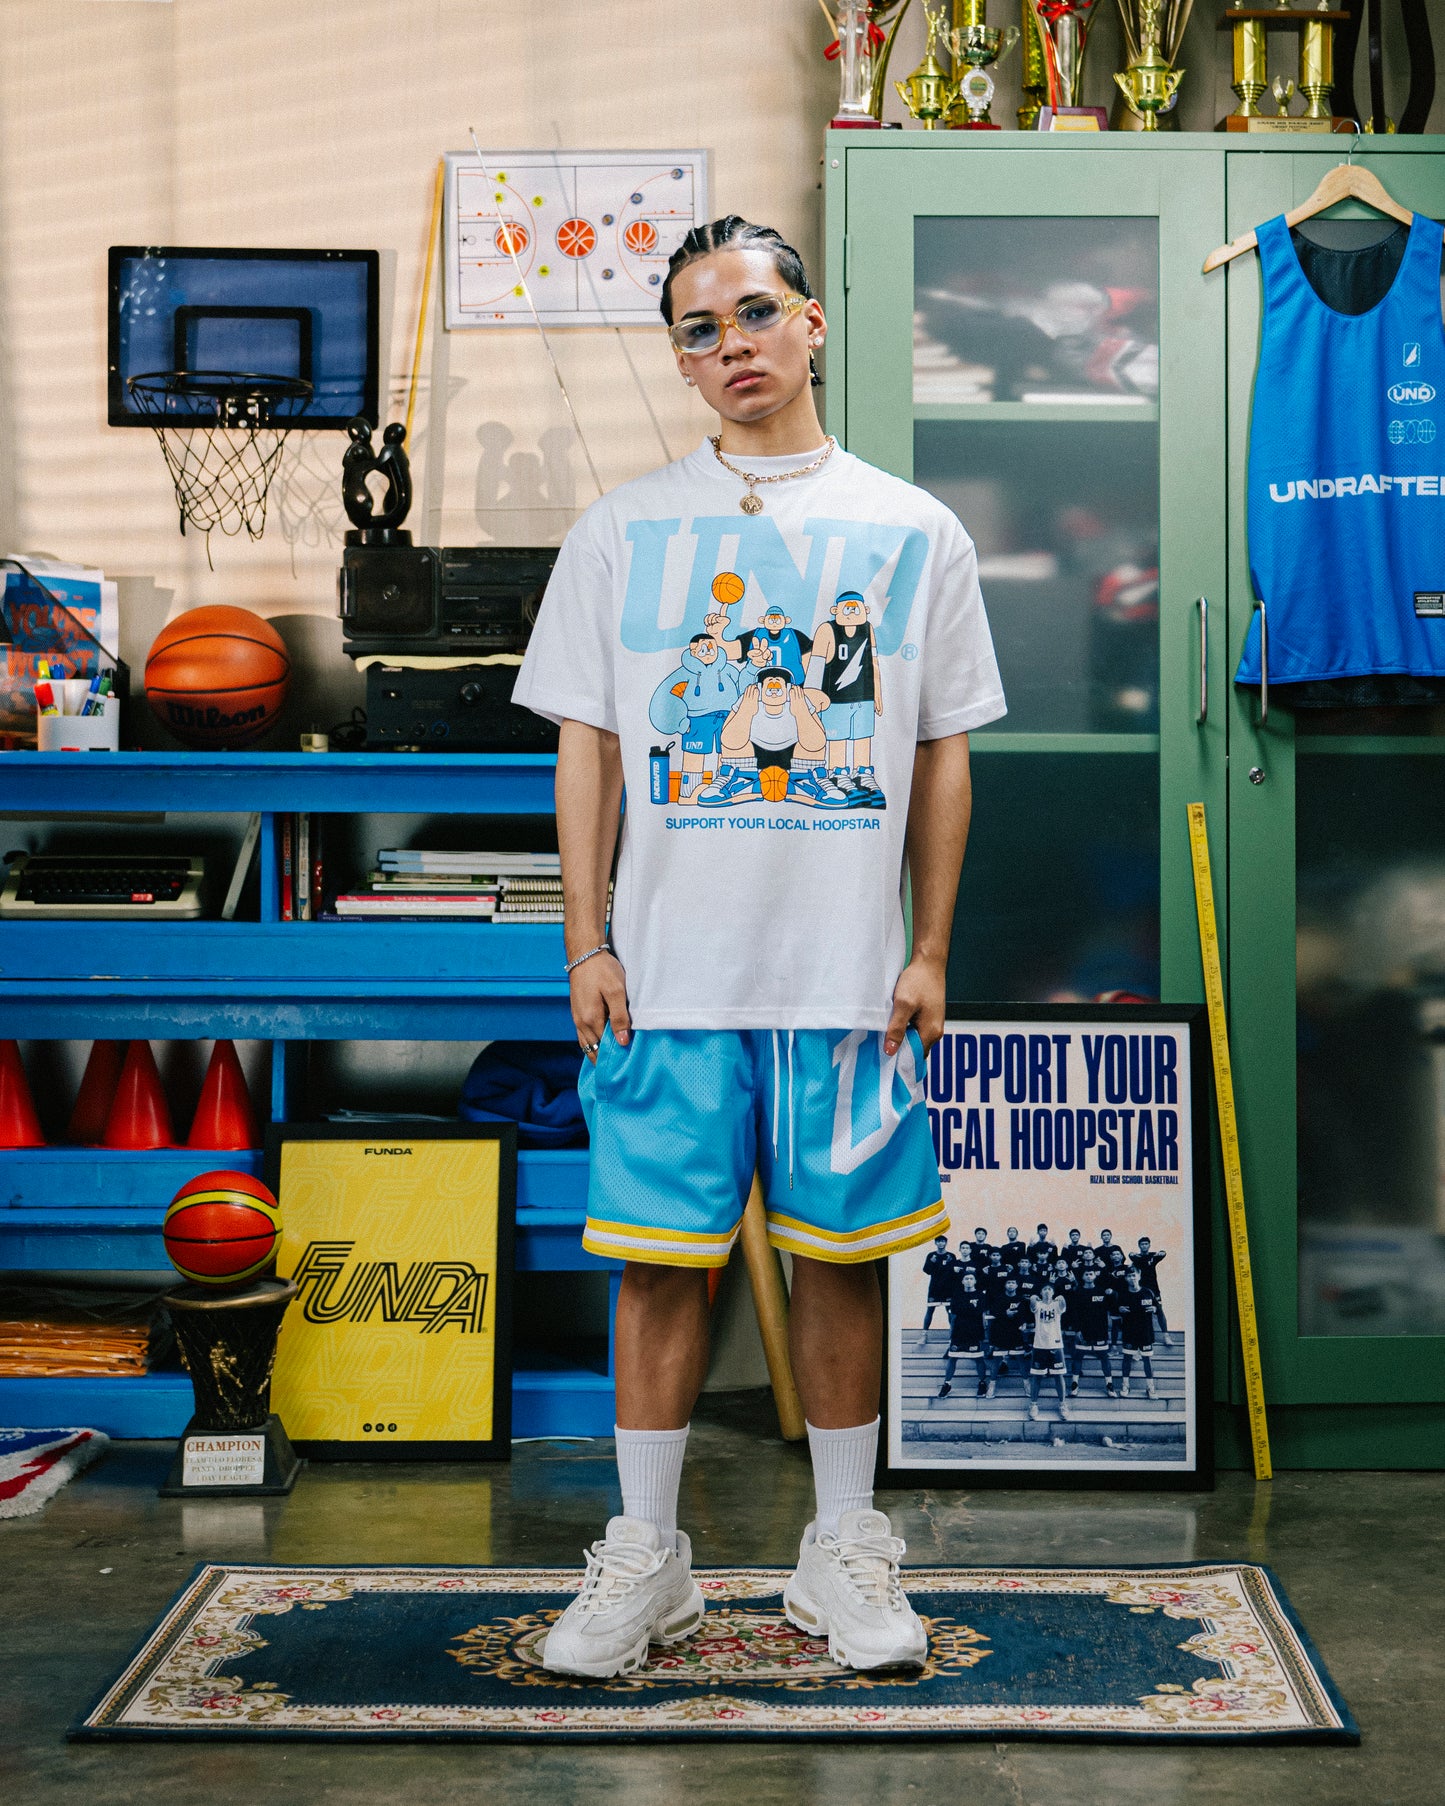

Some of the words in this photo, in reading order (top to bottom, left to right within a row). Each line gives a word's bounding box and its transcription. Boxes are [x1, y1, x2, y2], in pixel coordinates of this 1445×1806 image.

[1393, 386, 1431, 401] UND
[1269, 474, 1445, 503] UNDRAFTE
[166, 701, 266, 729] Wilson
[665, 817, 725, 829] SUPPORT
[728, 817, 765, 829] YOUR
[769, 818, 810, 830] LOCAL
[813, 818, 880, 831] HOOPSTAR
[922, 1034, 1071, 1103] UPPORT
[1082, 1034, 1178, 1105] YOUR
[928, 1107, 1000, 1170] CAL
[1010, 1108, 1179, 1171] HOOPSTAR
[1090, 1174, 1105, 1184] RIZAL
[1107, 1174, 1120, 1184] HIGH
[1122, 1175, 1143, 1184] SCHOOL
[1145, 1175, 1178, 1184] BASKETBALL
[291, 1241, 489, 1334] FUNDA
[186, 1440, 261, 1452] CHAMPION
